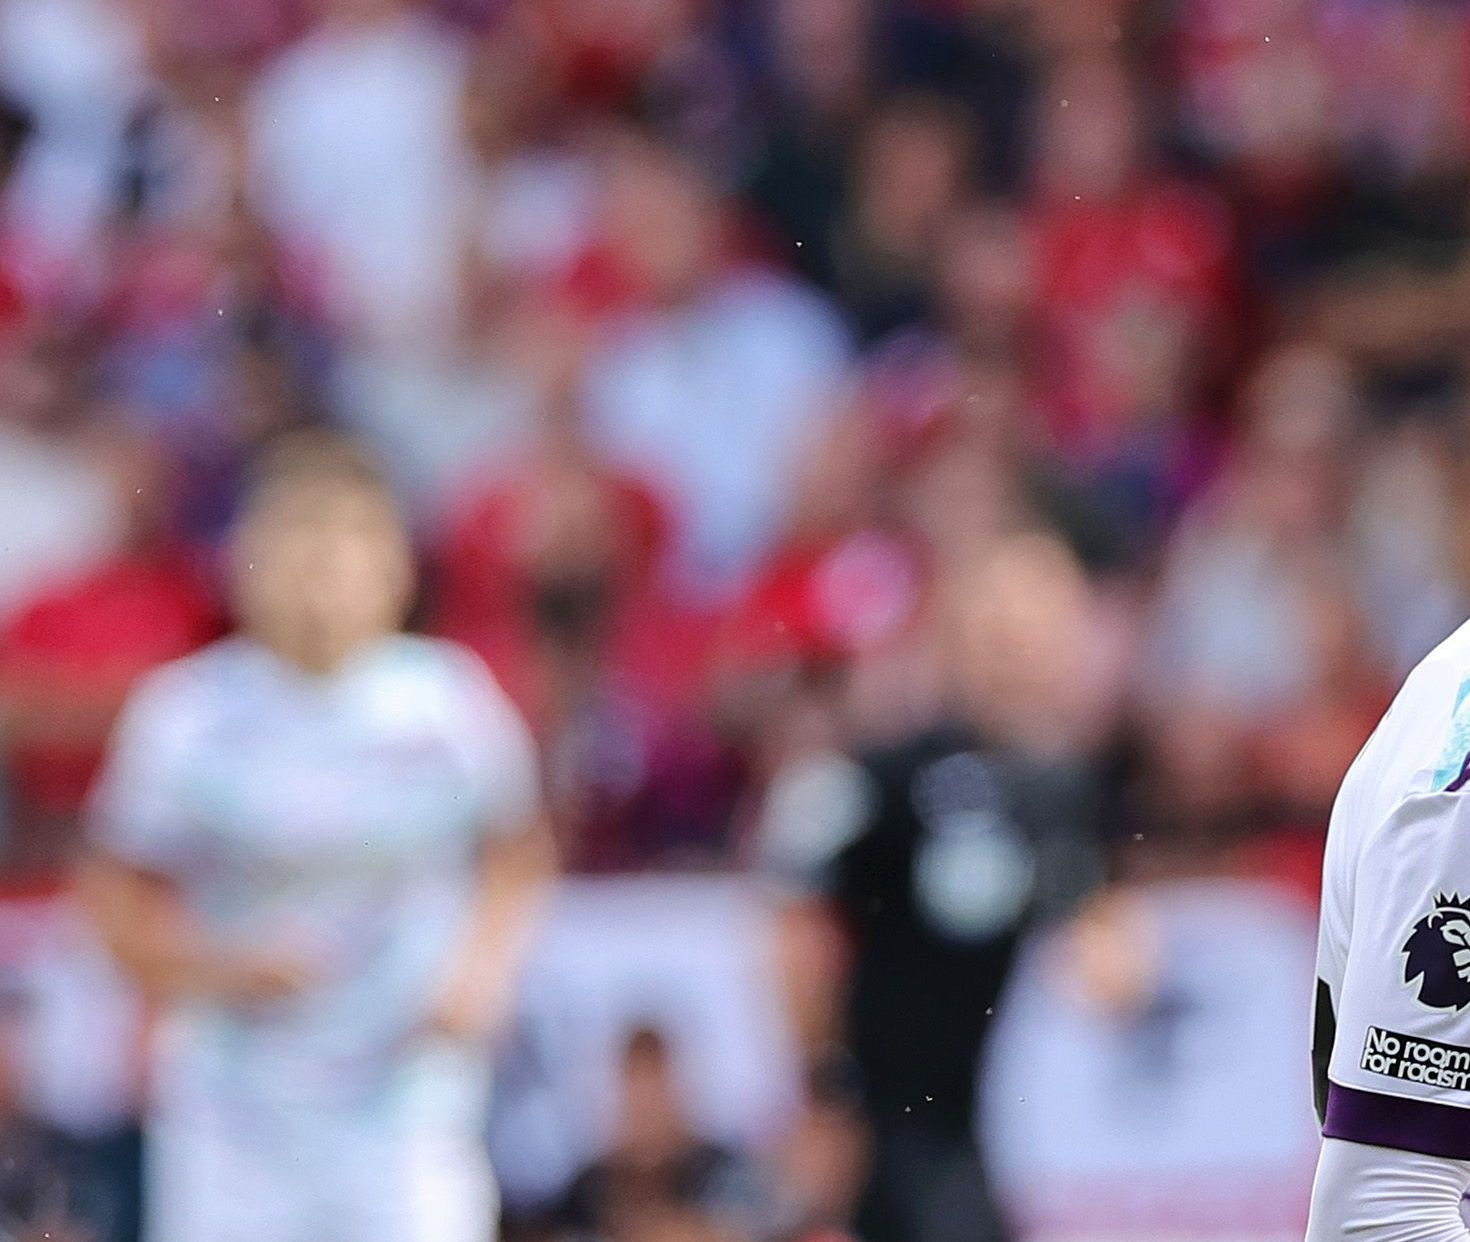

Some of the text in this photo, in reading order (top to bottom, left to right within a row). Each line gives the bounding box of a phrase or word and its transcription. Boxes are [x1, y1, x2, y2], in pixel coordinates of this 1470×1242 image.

[1360, 1047, 1397, 1075] for
[1365, 1026, 1470, 1070] No room
